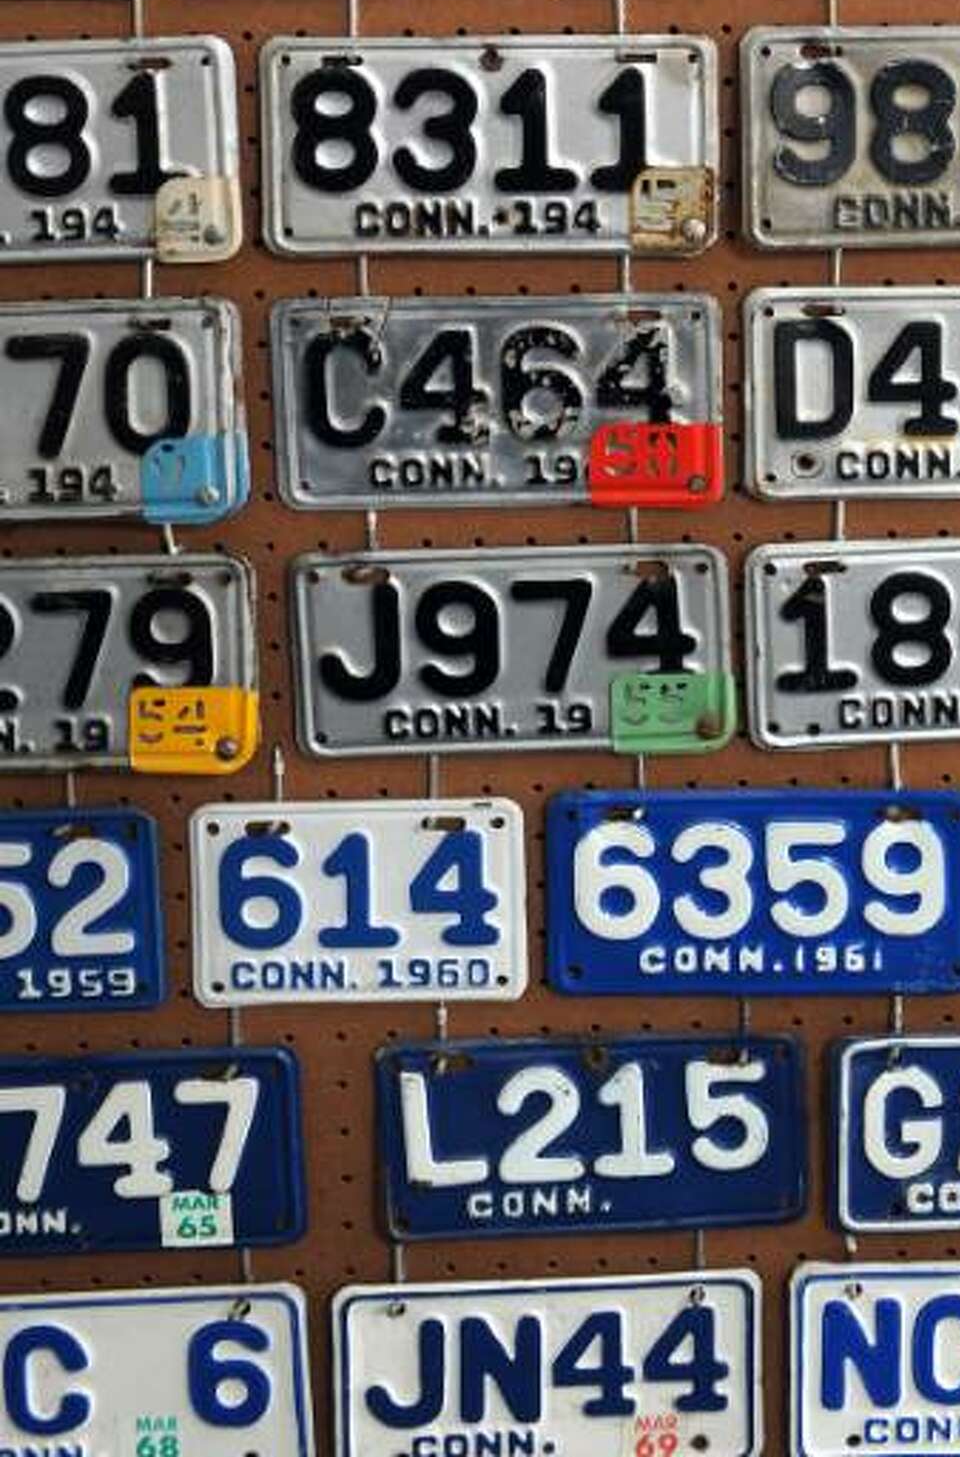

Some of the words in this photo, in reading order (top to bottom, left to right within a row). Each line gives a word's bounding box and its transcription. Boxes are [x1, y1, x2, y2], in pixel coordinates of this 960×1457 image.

[3, 70, 189, 197] 81
[291, 66, 646, 193] 8311
[30, 207, 121, 241] 194
[355, 205, 491, 236] CONN.
[511, 202, 601, 234] 194
[1, 331, 191, 459] 70
[302, 323, 689, 447] C464
[28, 468, 119, 503] 194
[369, 456, 504, 487] CONN.
[525, 453, 591, 484] 19
[0, 586, 214, 710] 79
[320, 566, 697, 701] J974
[384, 709, 518, 738] CONN.
[538, 703, 593, 734] 19
[218, 831, 500, 950] 614
[573, 820, 946, 940] 6359
[16, 967, 135, 999] 1959
[230, 959, 357, 991] CONN.
[379, 957, 490, 987] 1960
[0, 1077, 259, 1202] 747
[399, 1060, 769, 1188] L215
[177, 1216, 217, 1240] 65
[467, 1187, 613, 1218] CONN.
[3, 1324, 90, 1436] C
[187, 1320, 271, 1428] 6
[365, 1304, 729, 1429] JN44
[136, 1416, 178, 1432] MAR
[136, 1436, 179, 1457] 68
[634, 1434, 679, 1457] 69
